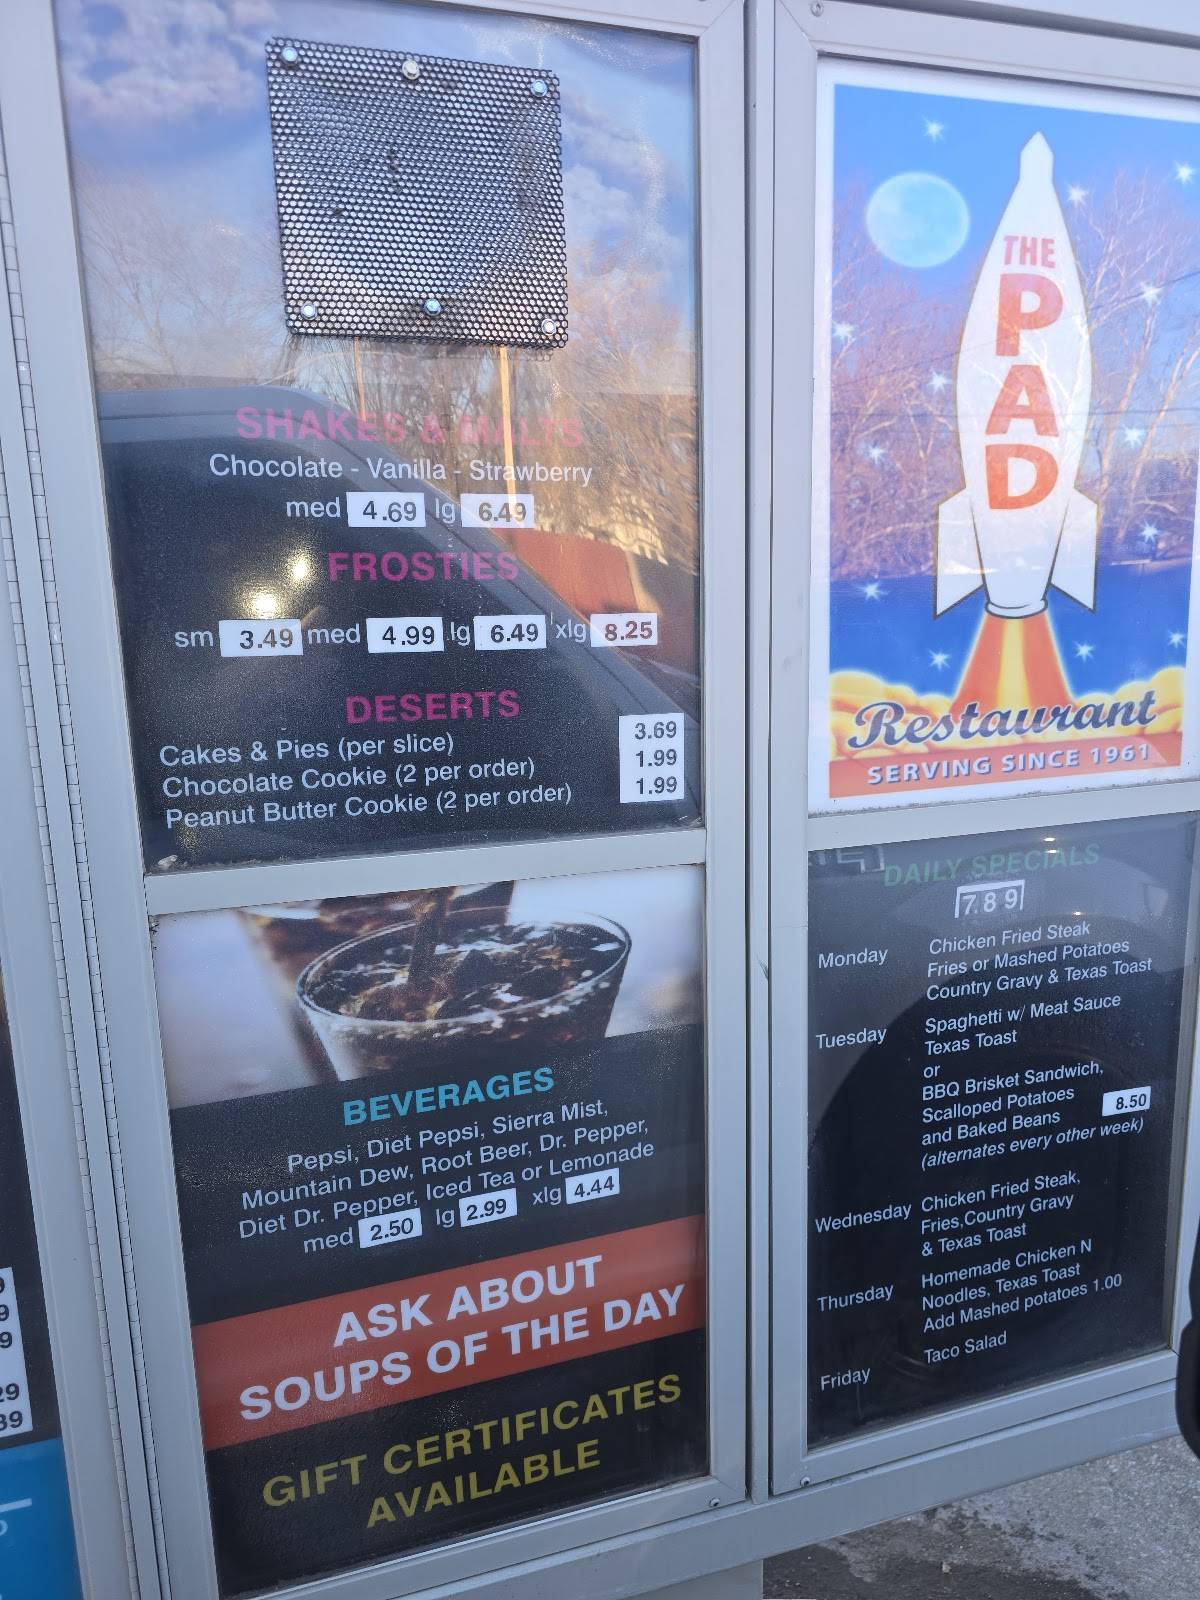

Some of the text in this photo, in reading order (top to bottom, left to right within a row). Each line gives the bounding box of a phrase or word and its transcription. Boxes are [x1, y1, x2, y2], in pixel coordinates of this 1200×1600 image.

[1003, 235, 1056, 268] THE
[985, 273, 1064, 509] PAD
[235, 406, 407, 444] SHAKES
[421, 416, 445, 444] &
[210, 454, 343, 478] Chocolate
[366, 457, 446, 479] Vanilla
[470, 460, 592, 487] Strawberry
[286, 498, 527, 523] med 4.69 lg 6.49
[328, 551, 519, 581] FROSTIES
[175, 620, 653, 649] sm 3.49 med 4.99 lg 6.49 xlg 8.25
[346, 690, 520, 725] DESERTS
[847, 689, 1158, 749] Restaurant
[160, 731, 454, 767] Cakes & Pies (per slice)
[634, 721, 677, 740] 3.69
[163, 756, 536, 798] Chocolate Cookie (2 per order)
[635, 749, 677, 767] 1.99
[867, 742, 1150, 786] SERVING SINCE 1961
[635, 777, 677, 795] 1.99
[166, 782, 572, 829] Peanut Butter Cookie (2 per order)
[884, 843, 1100, 887] DAILY SPECIALS
[930, 920, 1091, 954] Chicken Fried Steak
[818, 948, 888, 969] Monday
[927, 940, 1130, 978] Fries or Mashed Potatoes
[927, 959, 1153, 1001] Country Gravy & Texas Toast
[925, 995, 1121, 1035] Spaghetti w/ Meat Sauce
[816, 1028, 887, 1049] Tuesday
[925, 1030, 1017, 1055] Texas Toast
[922, 1060, 1104, 1101] BBQ Brisket Sandwich,
[924, 1065, 940, 1079] or
[343, 1067, 555, 1126] BEVERAGES
[922, 1087, 1075, 1124] Scalloped Potatoes
[1115, 1093, 1147, 1110] 8.50
[287, 1099, 609, 1174] Pepsi, Diet Pepsi, Sierra Mist,
[920, 1117, 1144, 1171] (alternates every other week)
[922, 1111, 1060, 1146] and Baked Beans
[242, 1118, 649, 1211] Mountain Dew, Root Beer, Dr. Pepper,
[239, 1142, 655, 1239] Diet Dr. Pepper, Iced Tea or Lemonade
[921, 1170, 1081, 1212] Chicken Fried Steak,
[1030, 1194, 1074, 1213] Gravy
[303, 1175, 615, 1254] med 2.50 lg 2.99 xlg 4.44
[815, 1203, 912, 1233] Wednesday
[921, 1223, 1027, 1257] & Texas Toast
[921, 1239, 1093, 1289] Homemade Chicken N
[333, 1255, 602, 1348] ASK ABOUT
[817, 1285, 894, 1313] Thursday
[922, 1263, 1081, 1311] Noodles, Texas Toast
[923, 1273, 1122, 1333] Add Mashed potatoes 1.00
[240, 1284, 684, 1420] SOUPS OF THE DAY
[925, 1331, 1007, 1364] Taco Salad
[820, 1367, 871, 1391] Friday
[262, 1374, 681, 1508] GIFT CERTIFICATES
[366, 1439, 600, 1528] AVAILABLE
